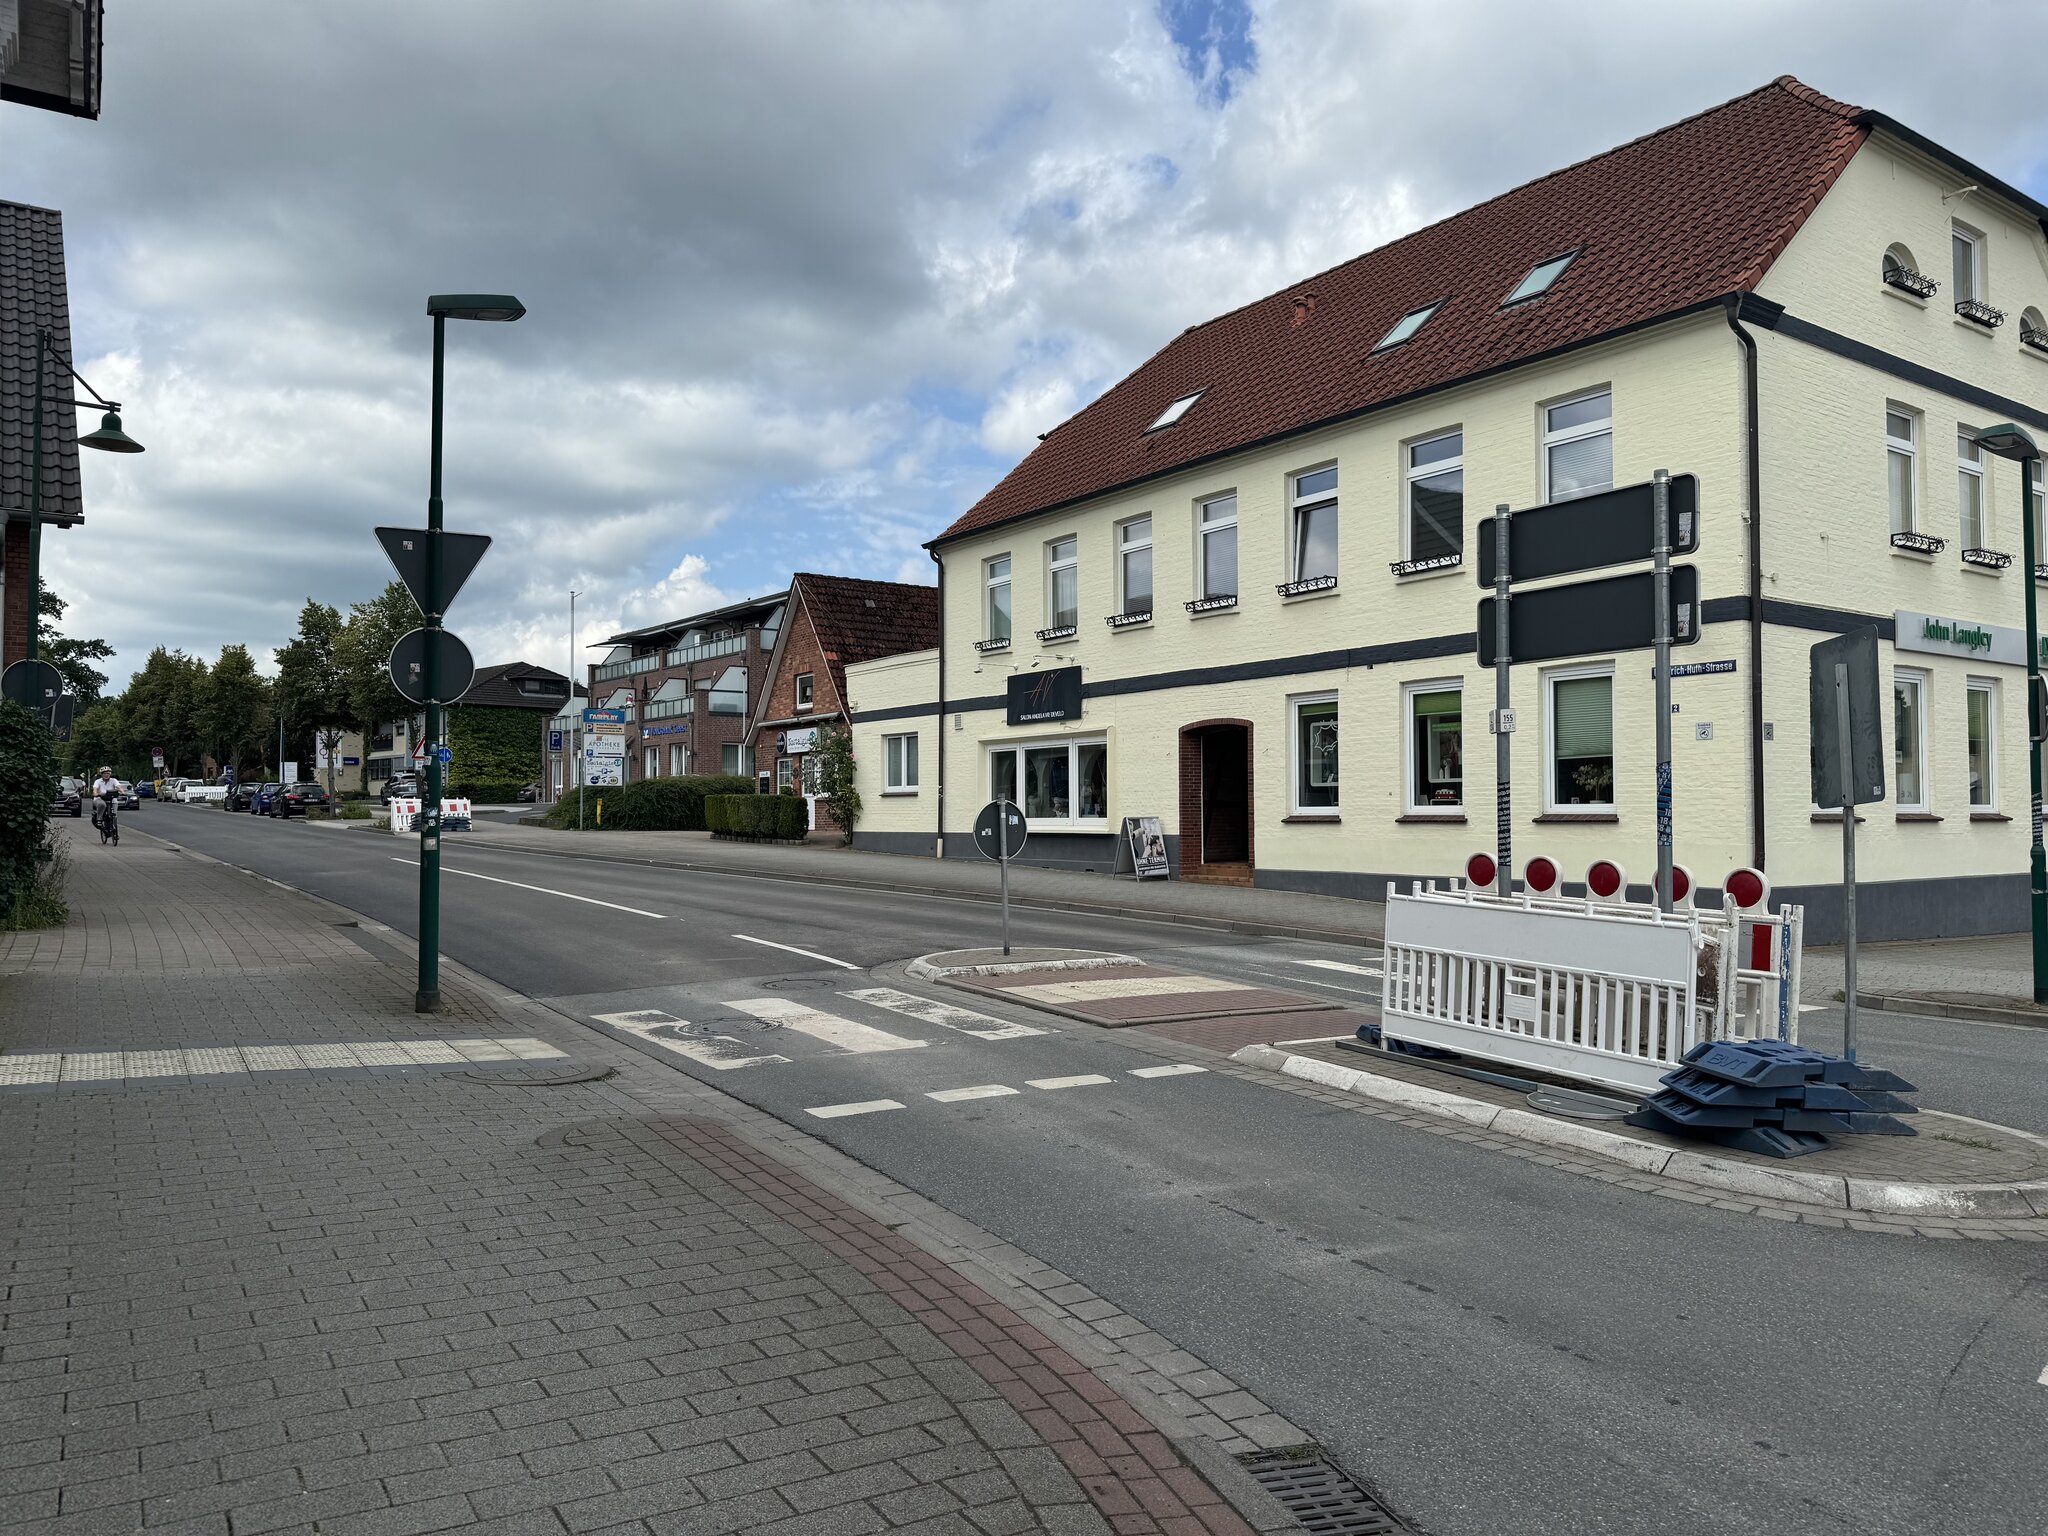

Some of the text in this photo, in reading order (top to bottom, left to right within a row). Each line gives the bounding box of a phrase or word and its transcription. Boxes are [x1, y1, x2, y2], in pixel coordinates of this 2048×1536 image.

[1923, 617, 1992, 652] John Langley
[1654, 662, 1734, 677] rich-Huth-Strasse
[551, 732, 560, 745] P
